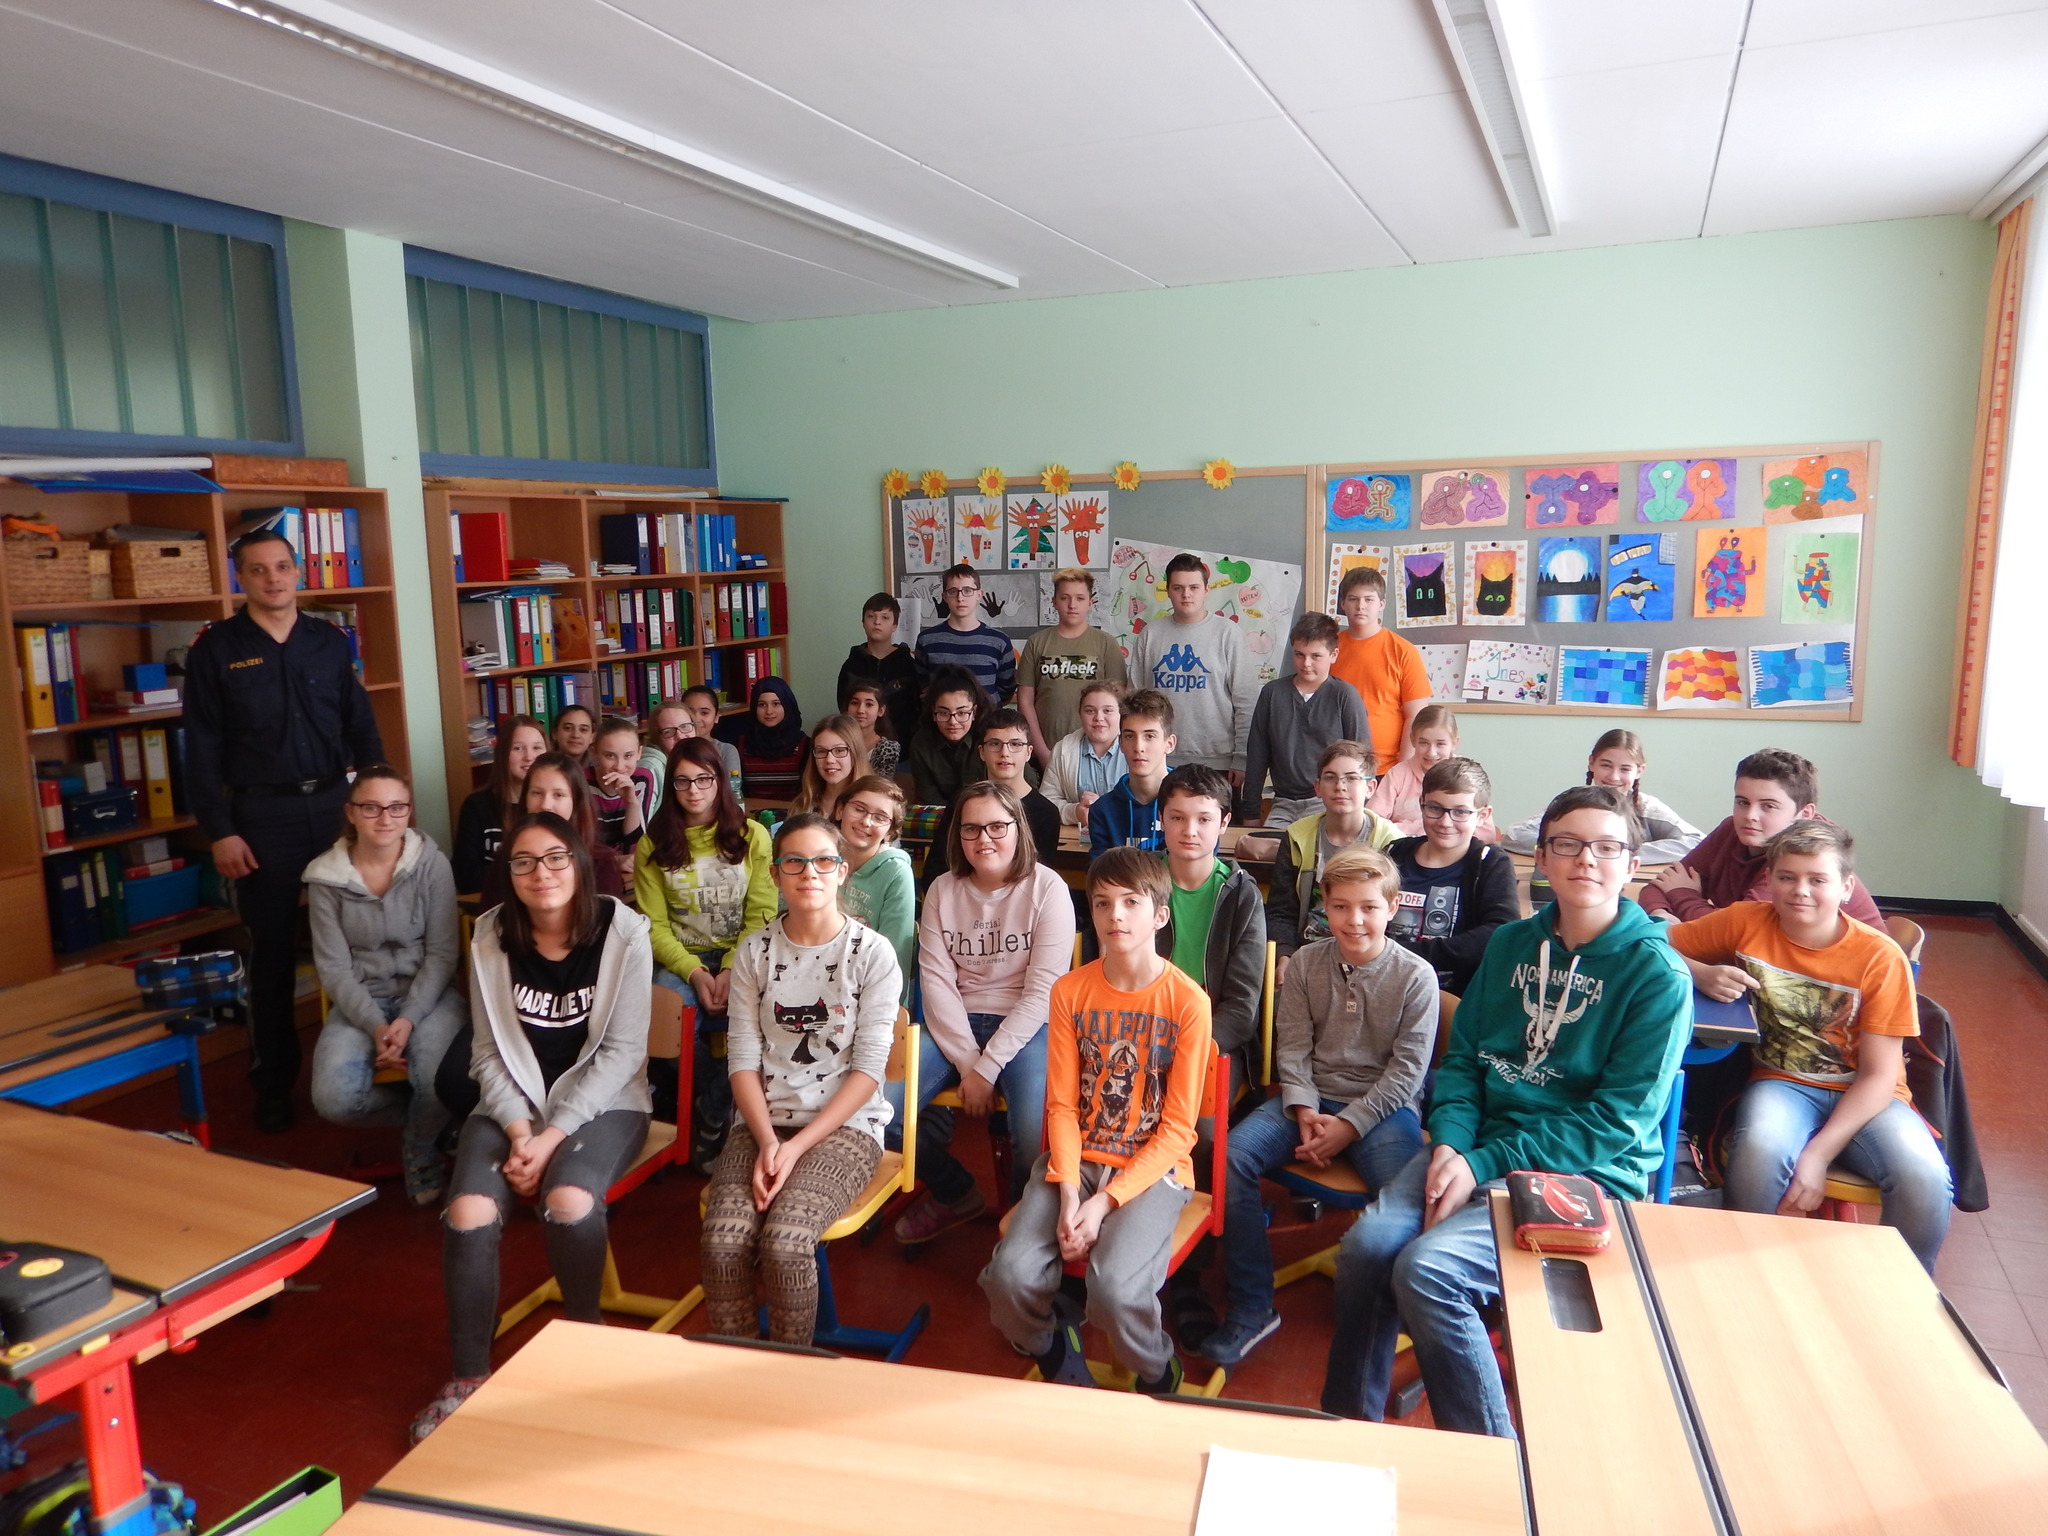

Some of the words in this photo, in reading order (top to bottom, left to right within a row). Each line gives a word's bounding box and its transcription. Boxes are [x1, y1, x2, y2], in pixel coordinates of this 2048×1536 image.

[229, 657, 264, 670] POLIZEI
[1041, 664, 1059, 675] on
[1060, 660, 1096, 675] fleek
[1153, 671, 1207, 692] Kappa
[973, 918, 1001, 929] Serial
[942, 930, 1032, 956] Chiller
[513, 983, 553, 1017] MADE
